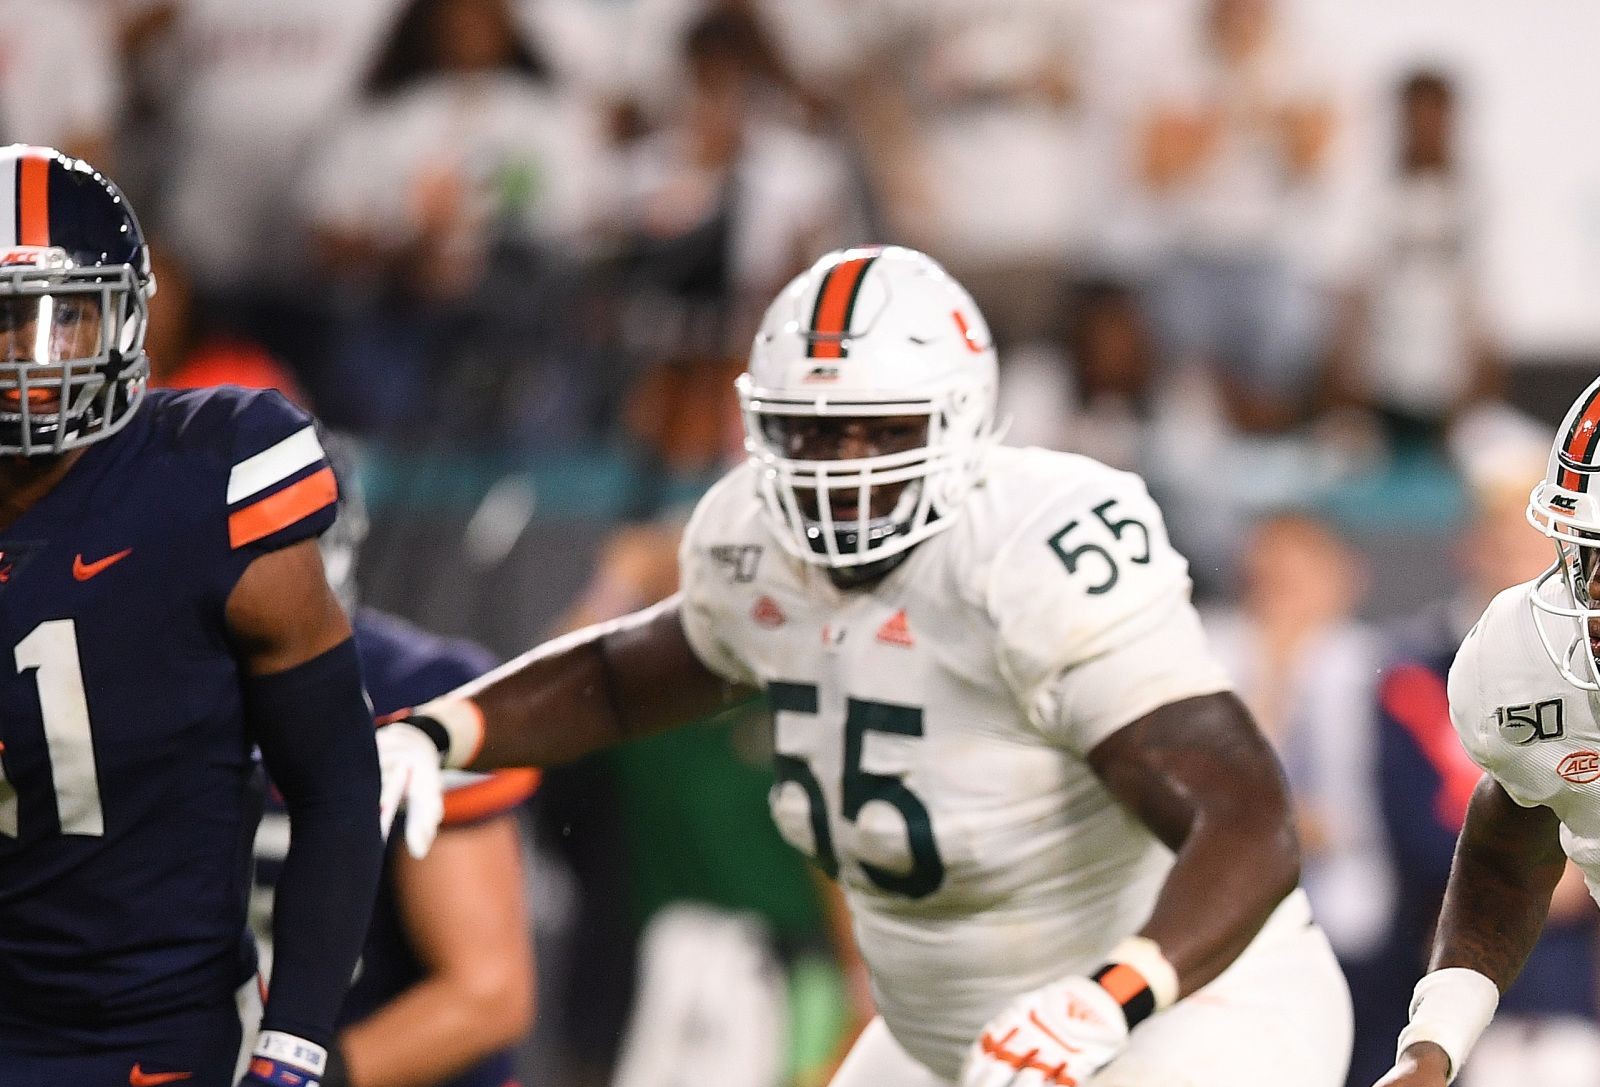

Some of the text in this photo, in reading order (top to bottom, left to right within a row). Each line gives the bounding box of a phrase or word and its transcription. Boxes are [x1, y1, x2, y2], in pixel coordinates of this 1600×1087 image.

[1048, 498, 1150, 595] 55
[0, 617, 104, 839] 1
[767, 681, 945, 898] 55
[1493, 698, 1562, 744] 150
